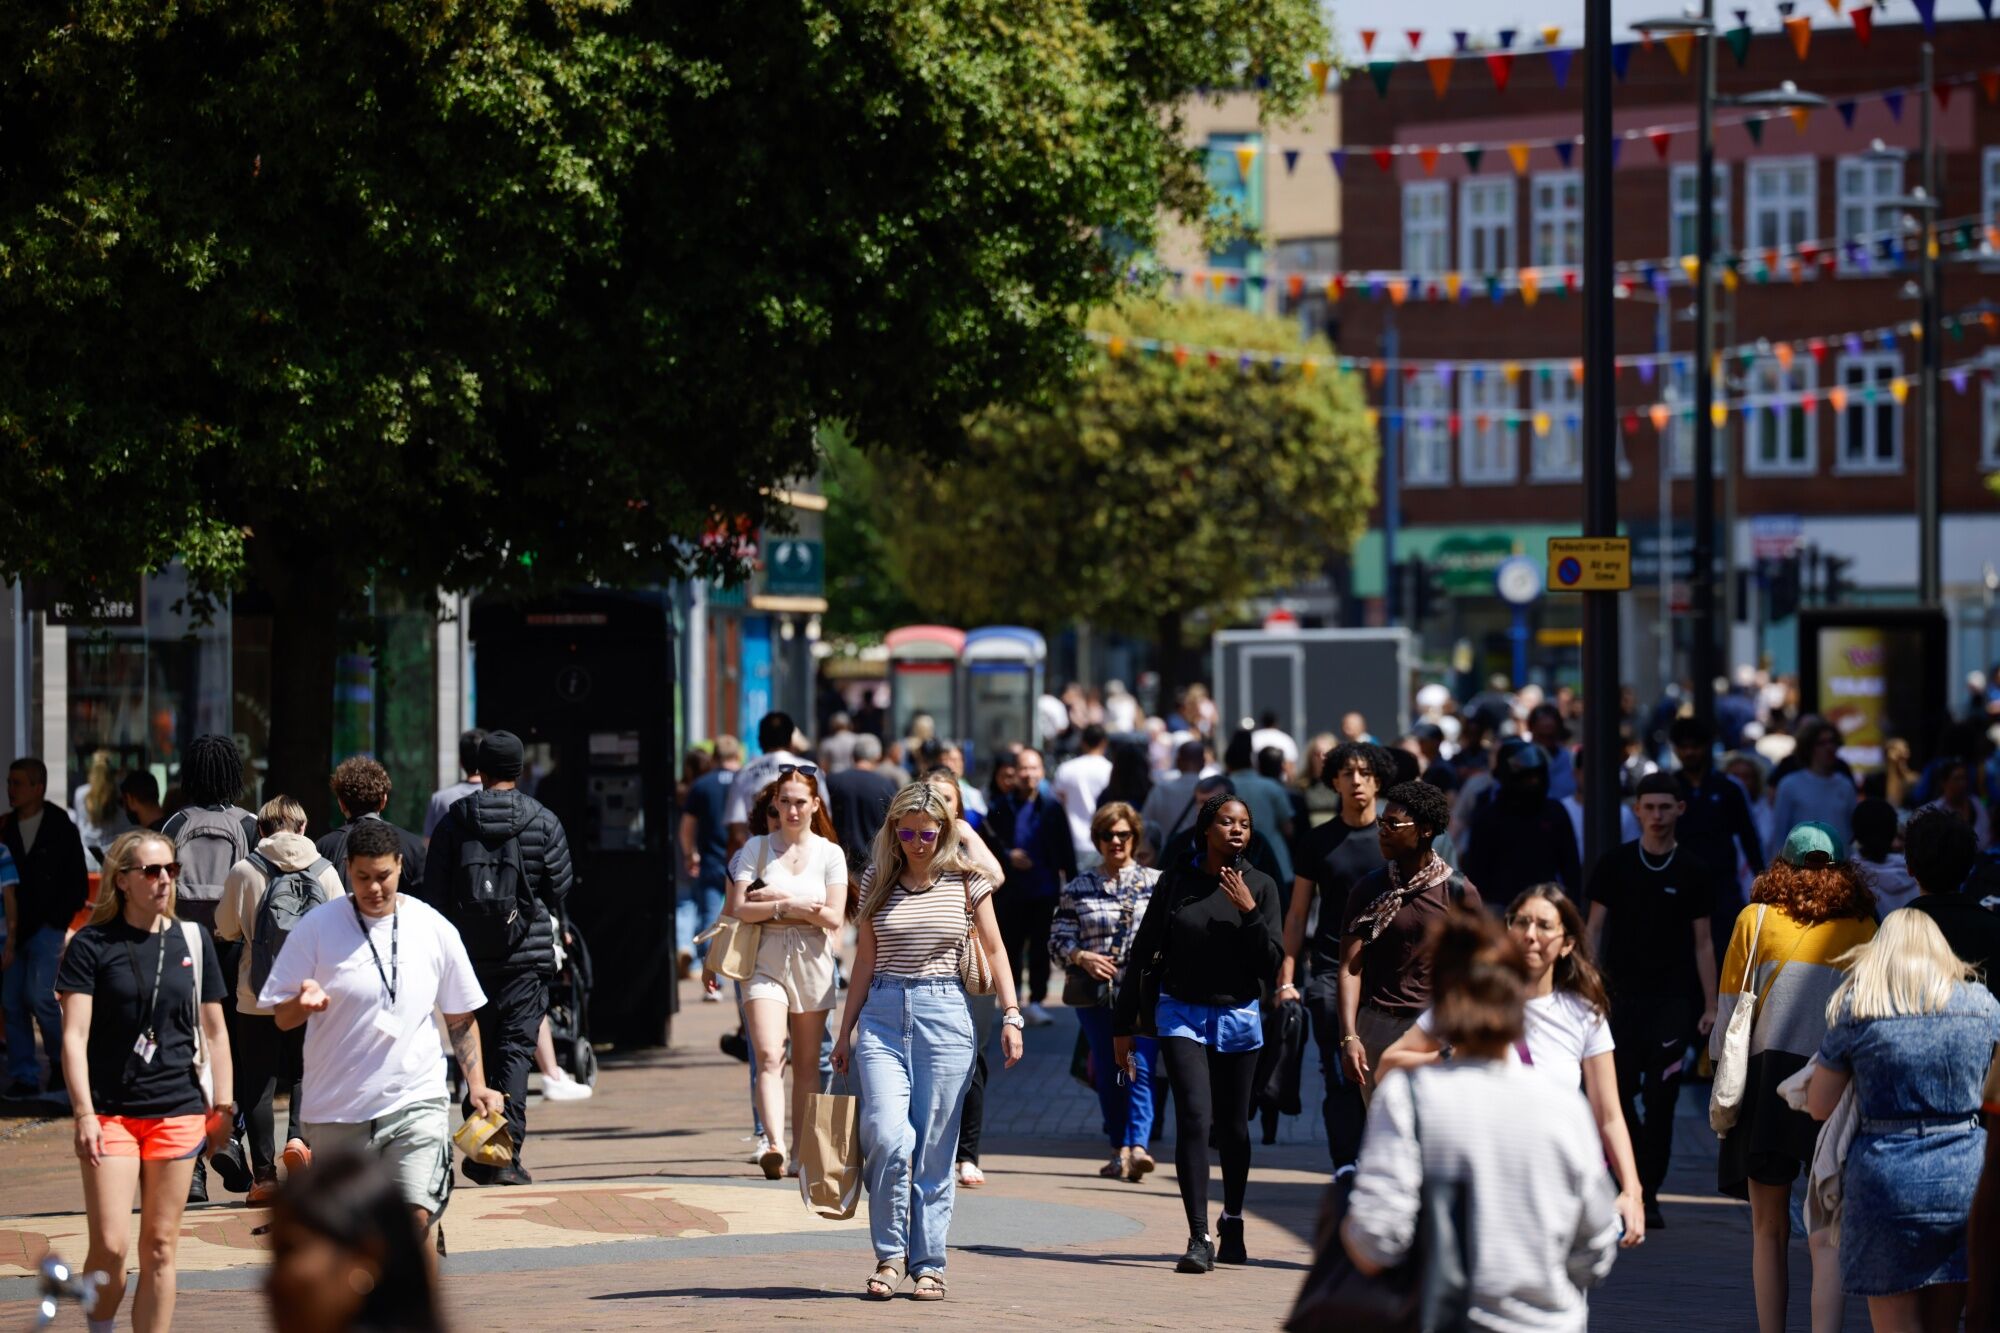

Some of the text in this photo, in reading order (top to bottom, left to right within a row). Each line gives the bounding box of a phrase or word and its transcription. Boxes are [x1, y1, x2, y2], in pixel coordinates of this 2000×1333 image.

[1552, 542, 1626, 551] Pedestrian Zone
[1590, 560, 1620, 571] At any
[1594, 572, 1615, 581] time
